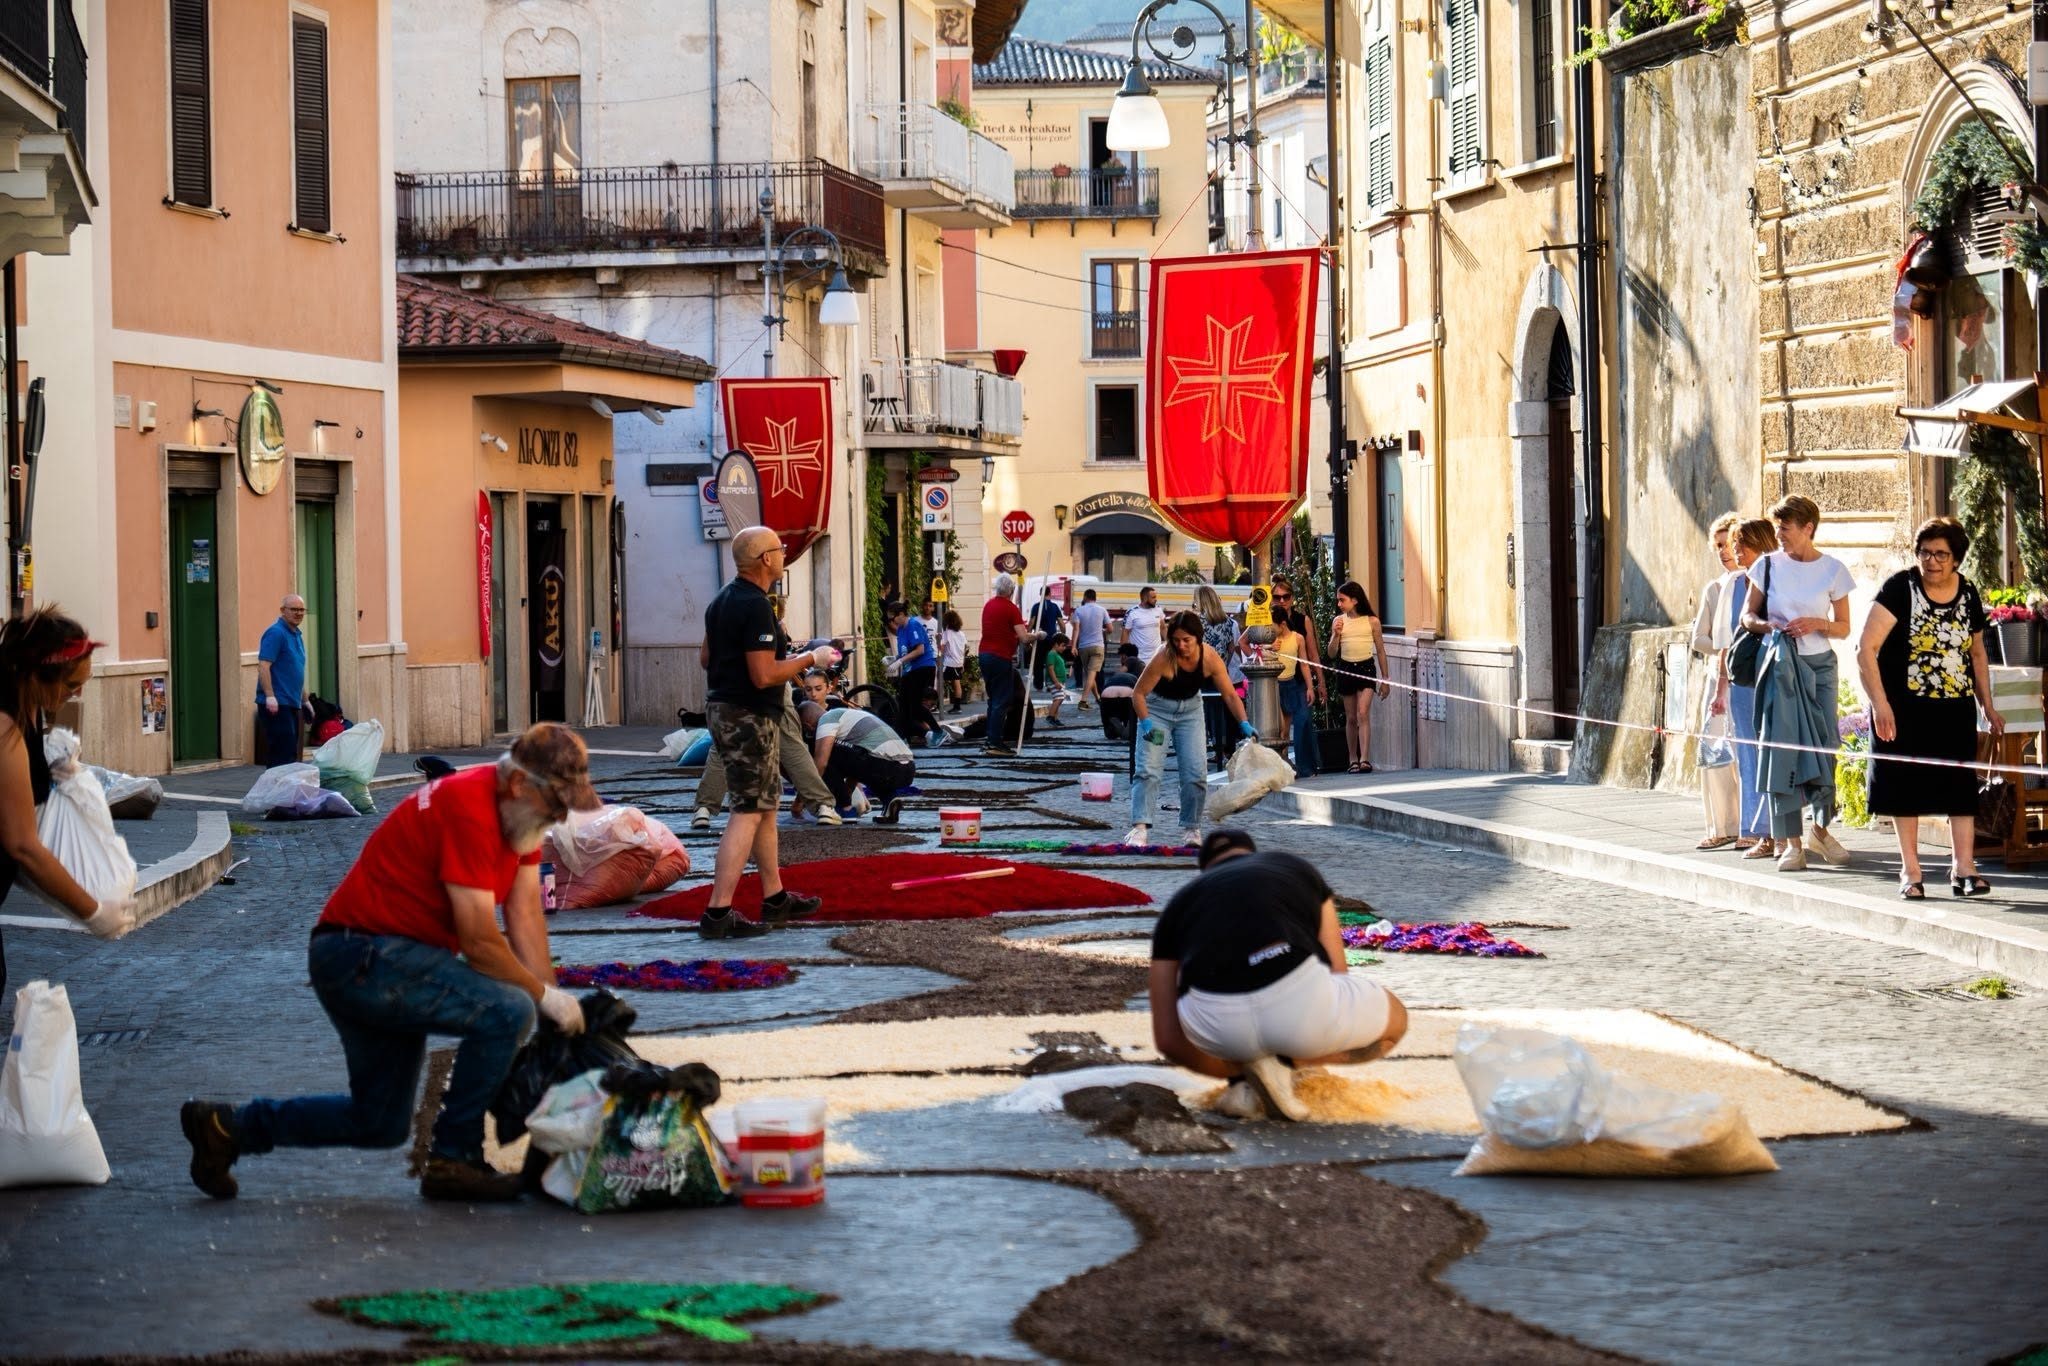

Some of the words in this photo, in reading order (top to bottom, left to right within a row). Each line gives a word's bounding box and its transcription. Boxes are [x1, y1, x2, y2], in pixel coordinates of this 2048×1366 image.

[983, 124, 1005, 133] Bed
[1020, 124, 1071, 134] Breakfast
[563, 431, 578, 467] 82
[1075, 494, 1125, 517] Portella
[1003, 520, 1034, 533] STOP
[544, 577, 560, 653] AKU
